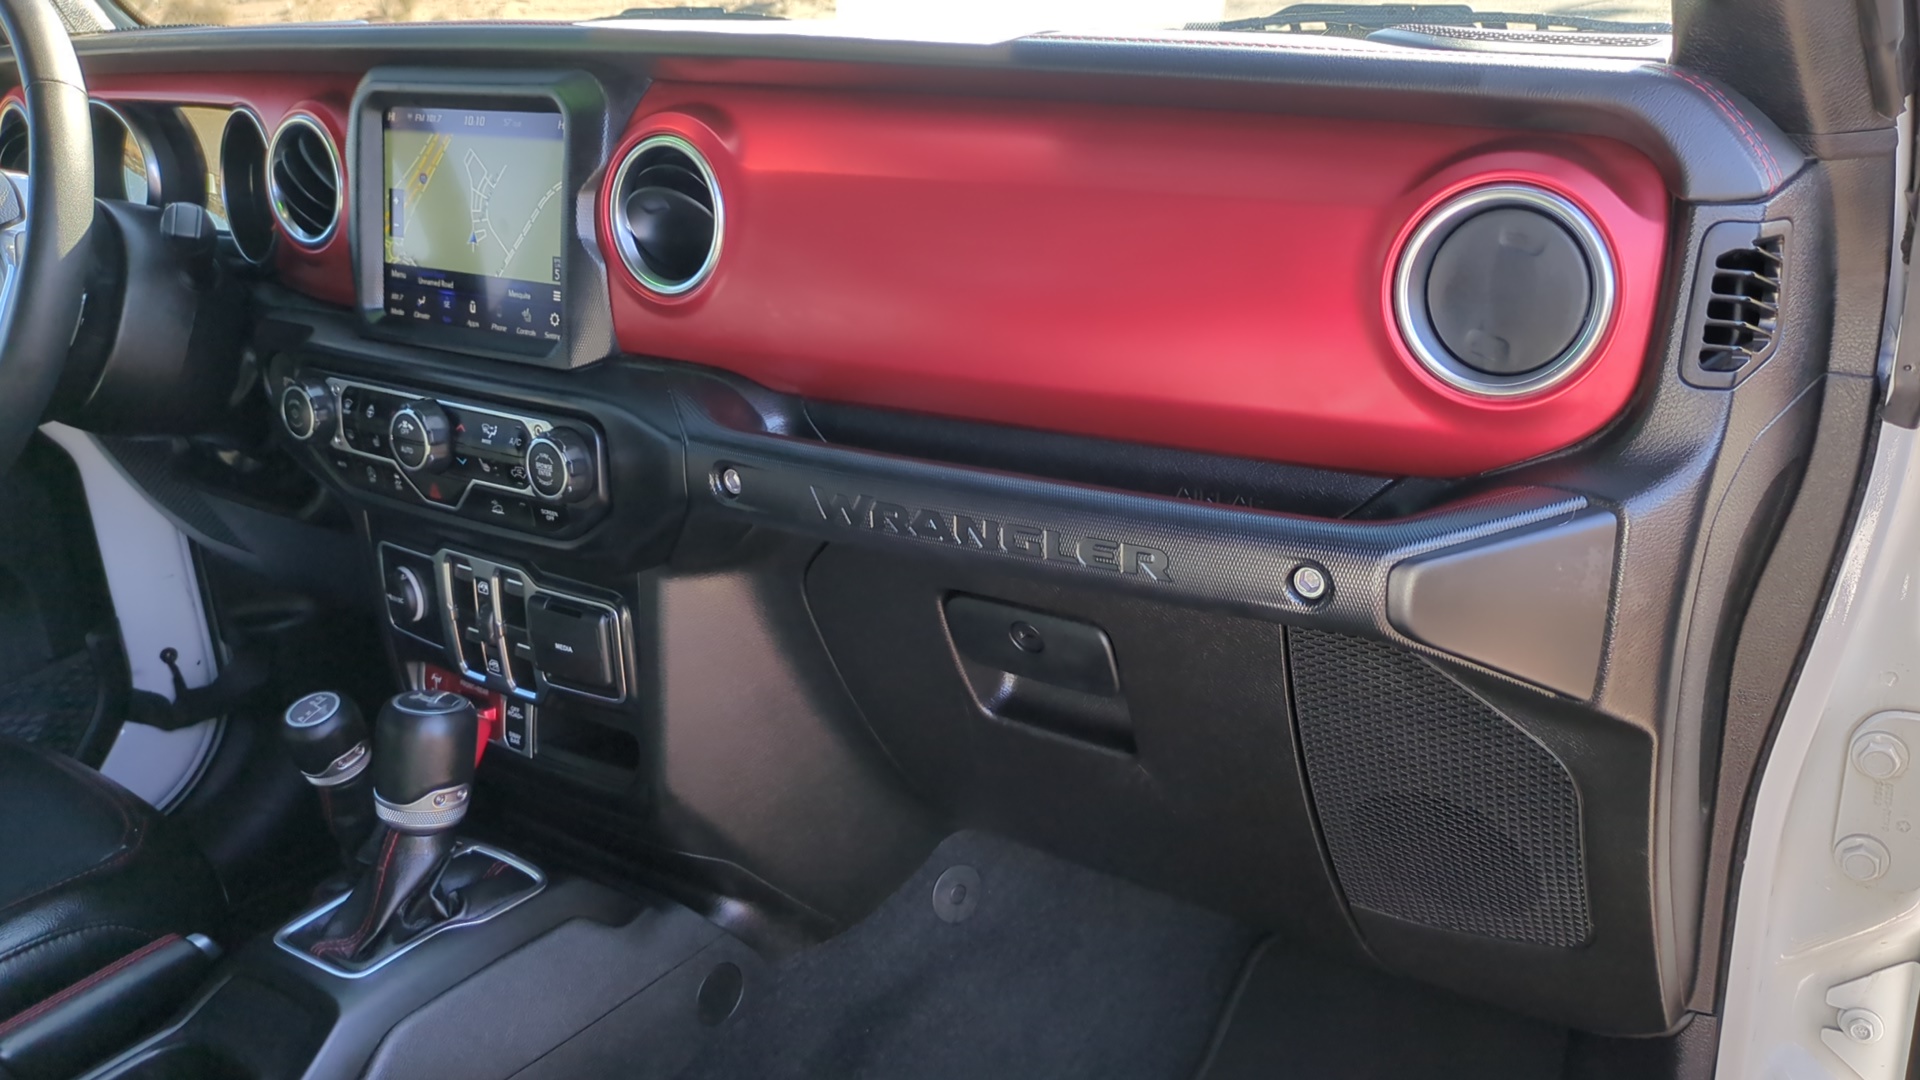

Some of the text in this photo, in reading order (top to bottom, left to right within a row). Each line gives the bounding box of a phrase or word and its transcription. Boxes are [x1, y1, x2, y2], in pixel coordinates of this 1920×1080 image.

[390, 269, 407, 279] Menu
[417, 276, 454, 289] Unnamed Road
[508, 289, 531, 300] Mesquite
[491, 323, 507, 332] Phone
[516, 327, 537, 337] Controls
[508, 437, 522, 447] A/C
[809, 484, 1174, 583] WRANGLER
[554, 642, 574, 654] MEDIA
